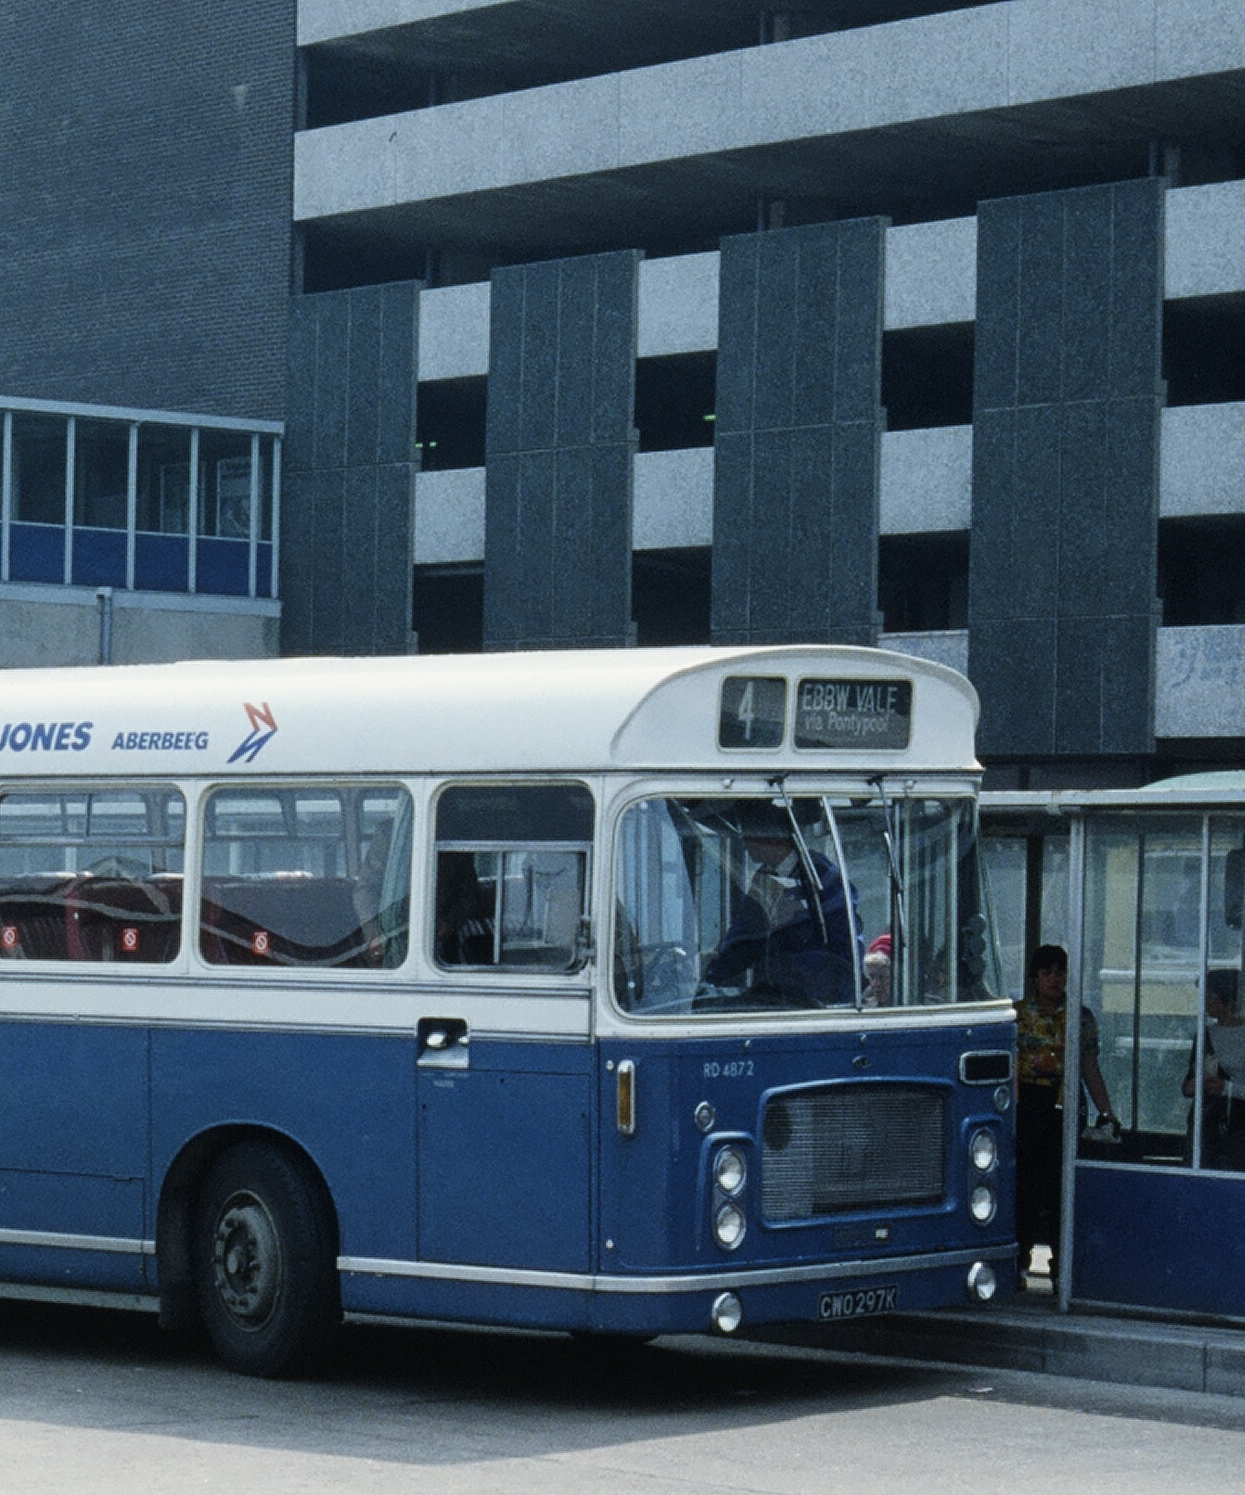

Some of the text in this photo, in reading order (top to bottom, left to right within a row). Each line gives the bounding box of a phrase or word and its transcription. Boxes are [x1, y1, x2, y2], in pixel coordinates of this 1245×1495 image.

[737, 681, 755, 740] 4
[801, 683, 898, 713] EBBW VALE
[804, 713, 823, 731] via
[111, 731, 209, 751] ABERBEEG
[723, 1060, 754, 1077] 4872
[820, 1288, 896, 1318] CWO297K
